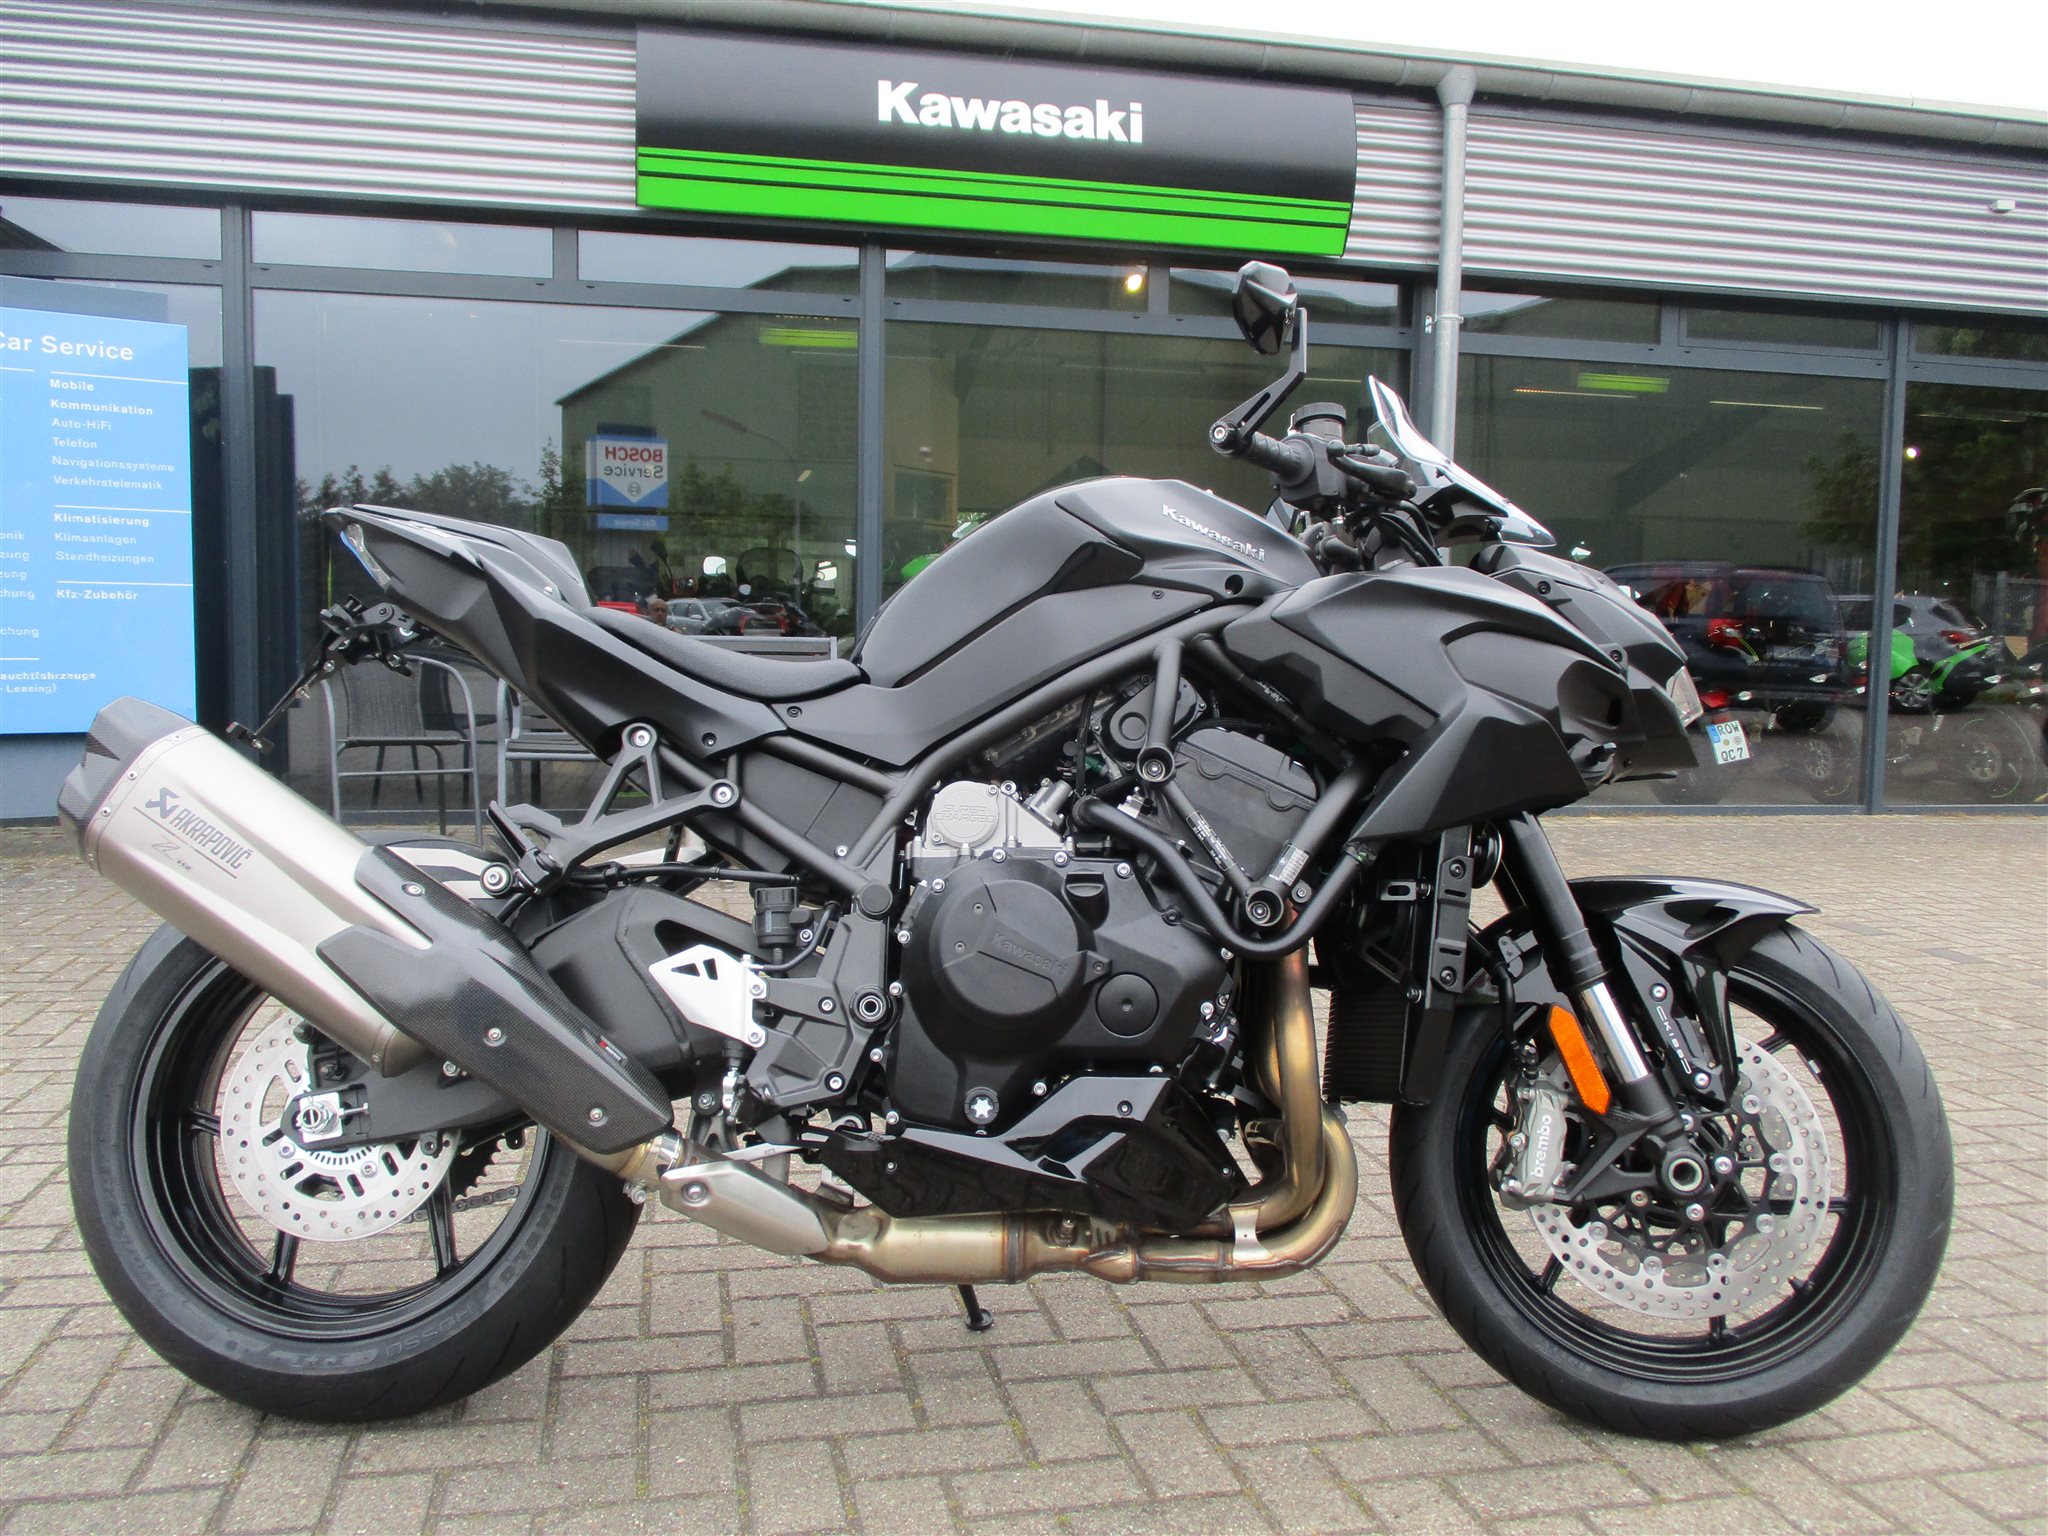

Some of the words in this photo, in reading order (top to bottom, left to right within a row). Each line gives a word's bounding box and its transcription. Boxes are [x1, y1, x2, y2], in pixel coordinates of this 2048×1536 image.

[878, 79, 1143, 144] Kawasaki
[41, 335, 134, 361] Service
[50, 379, 94, 391] Mobile
[51, 399, 153, 416] Kommunikation
[52, 437, 98, 449] Telefon
[52, 456, 175, 472] Navigationssysteme
[53, 475, 164, 490] Verkehrstelematik
[54, 512, 150, 528] Klimatisierung
[54, 532, 137, 546] Klimaanlagen
[1162, 504, 1265, 562] Kawasaki
[55, 550, 155, 565] Standheizungen
[56, 589, 139, 601] Kfz-Zubehör
[1717, 722, 1740, 736] ROW
[1721, 748, 1736, 762] QC
[1737, 747, 1743, 758] 7
[991, 931, 1071, 977] Kawasaki
[1530, 1114, 1552, 1178] brembo
